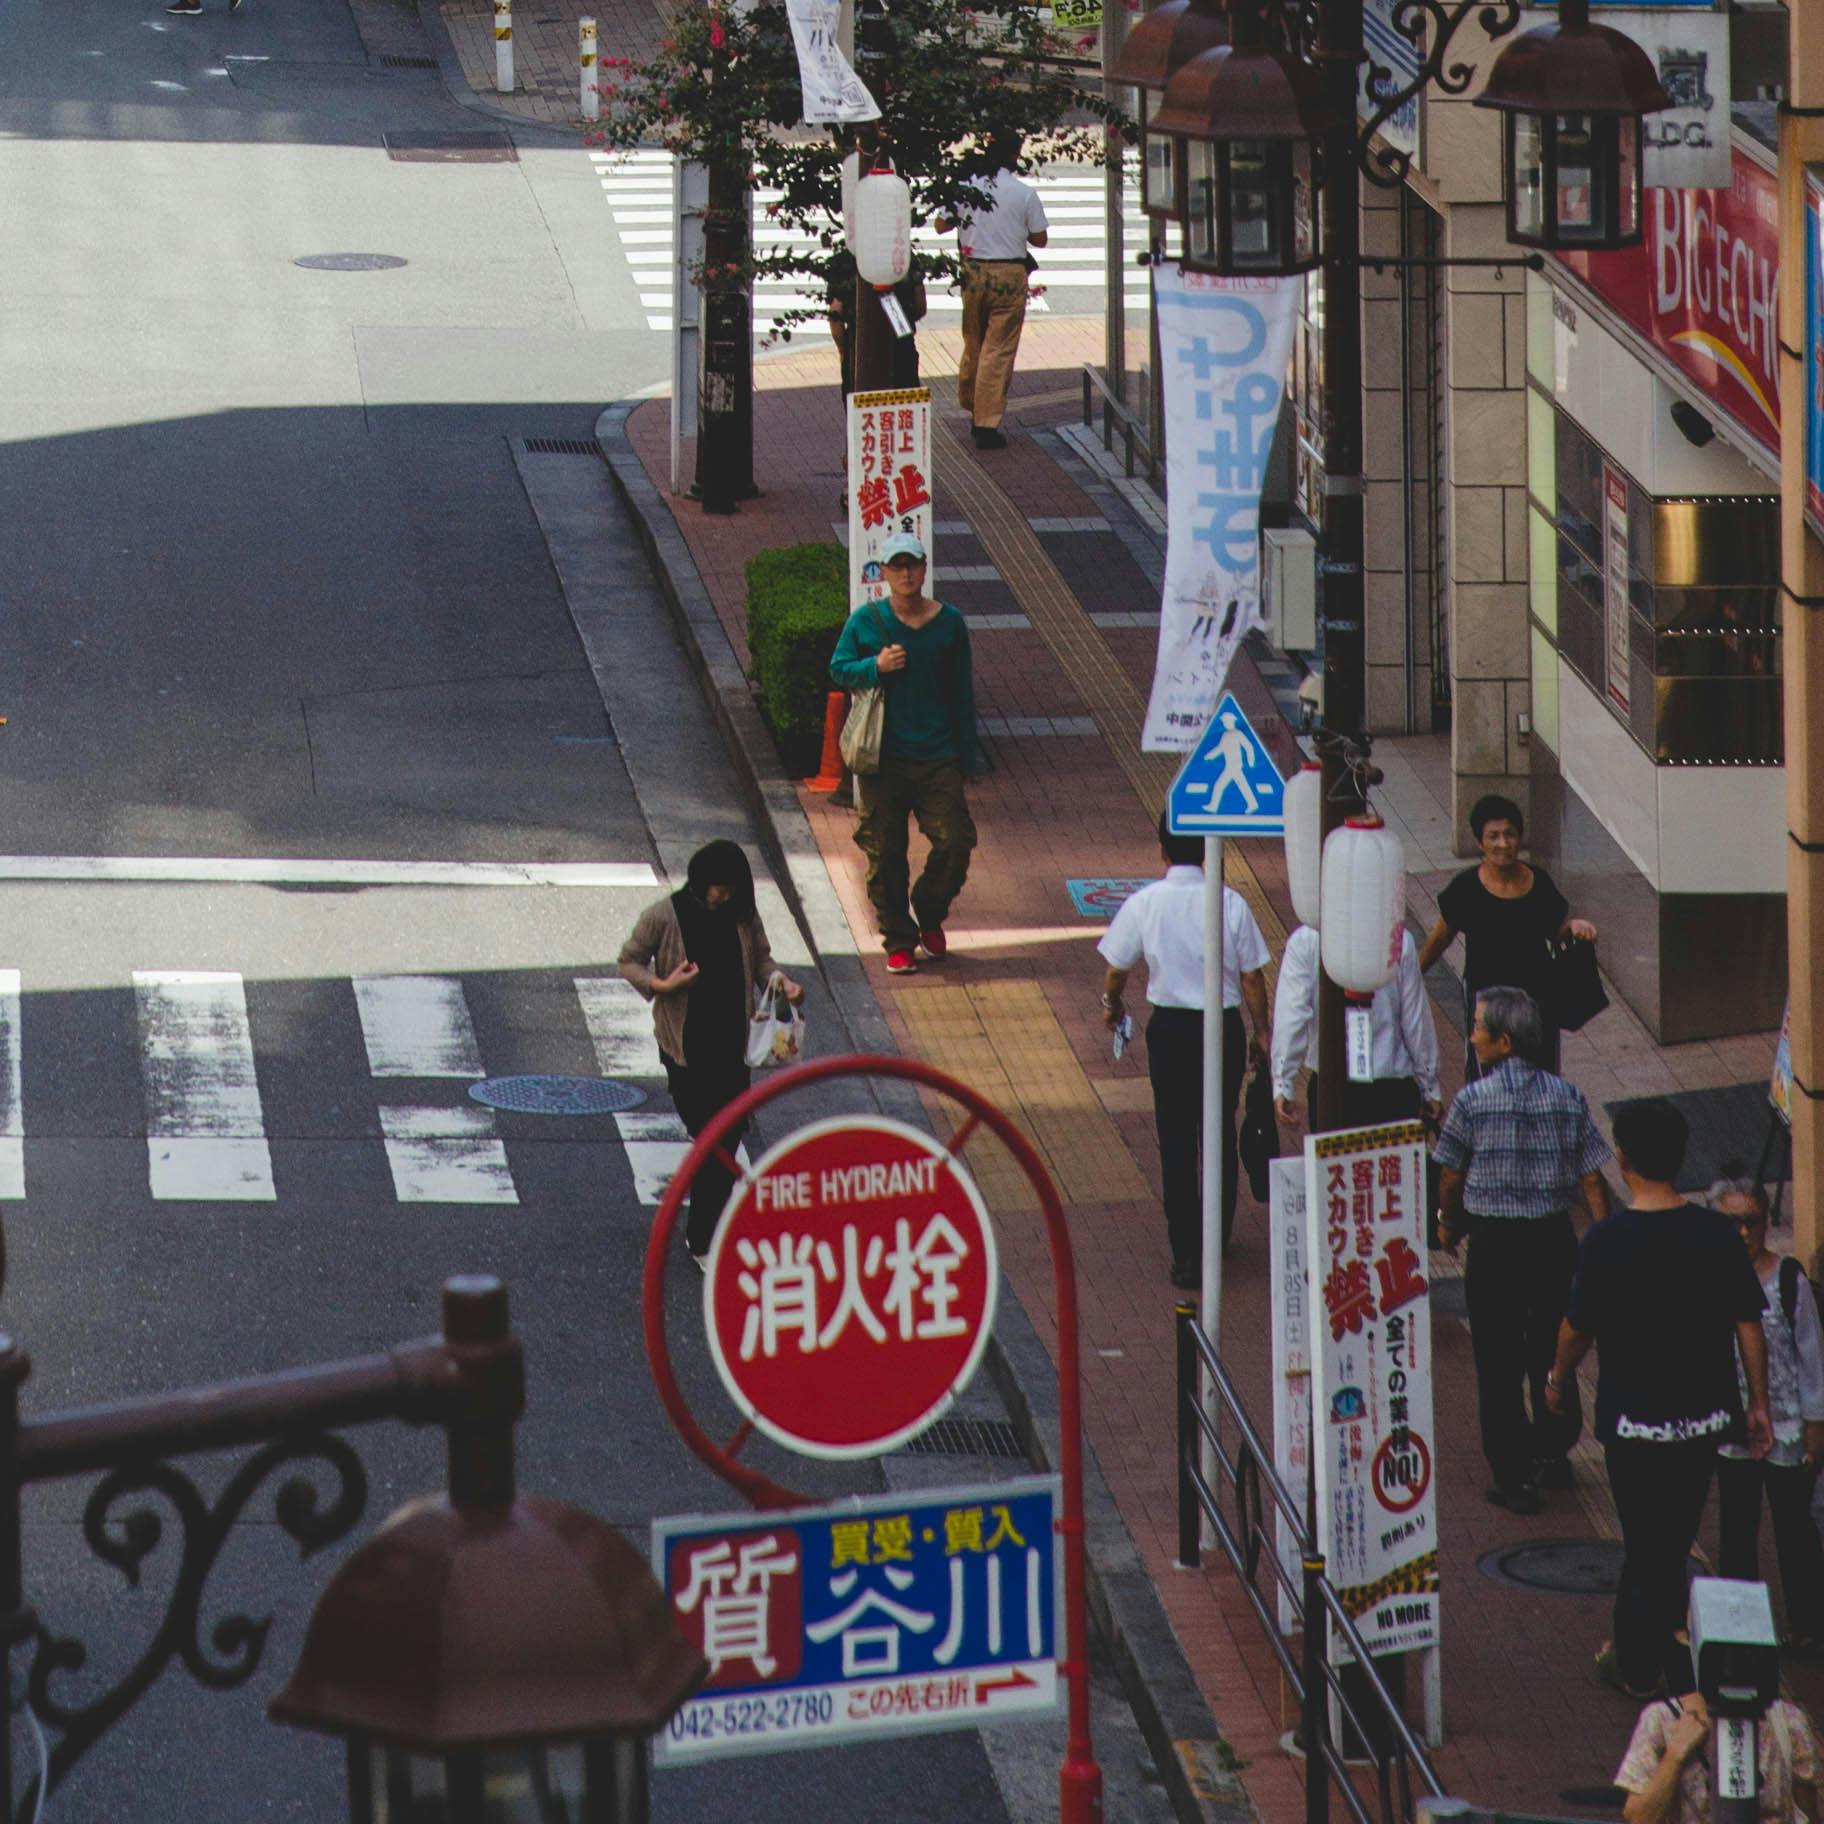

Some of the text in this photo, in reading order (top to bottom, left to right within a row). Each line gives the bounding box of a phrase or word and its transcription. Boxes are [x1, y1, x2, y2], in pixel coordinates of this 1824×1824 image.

[1656, 184, 1714, 315] BIG
[755, 1160, 940, 1213] FIRE HYDRANT
[734, 1212, 970, 1364] 消火栓
[828, 1506, 1027, 1569] 買受・質入
[674, 1535, 798, 1681] 質
[804, 1545, 1043, 1680] 谷川
[1376, 1602, 1432, 1630] NO MORE
[670, 1690, 834, 1744] 042-522-2780
[845, 1665, 972, 1721] この先右折
